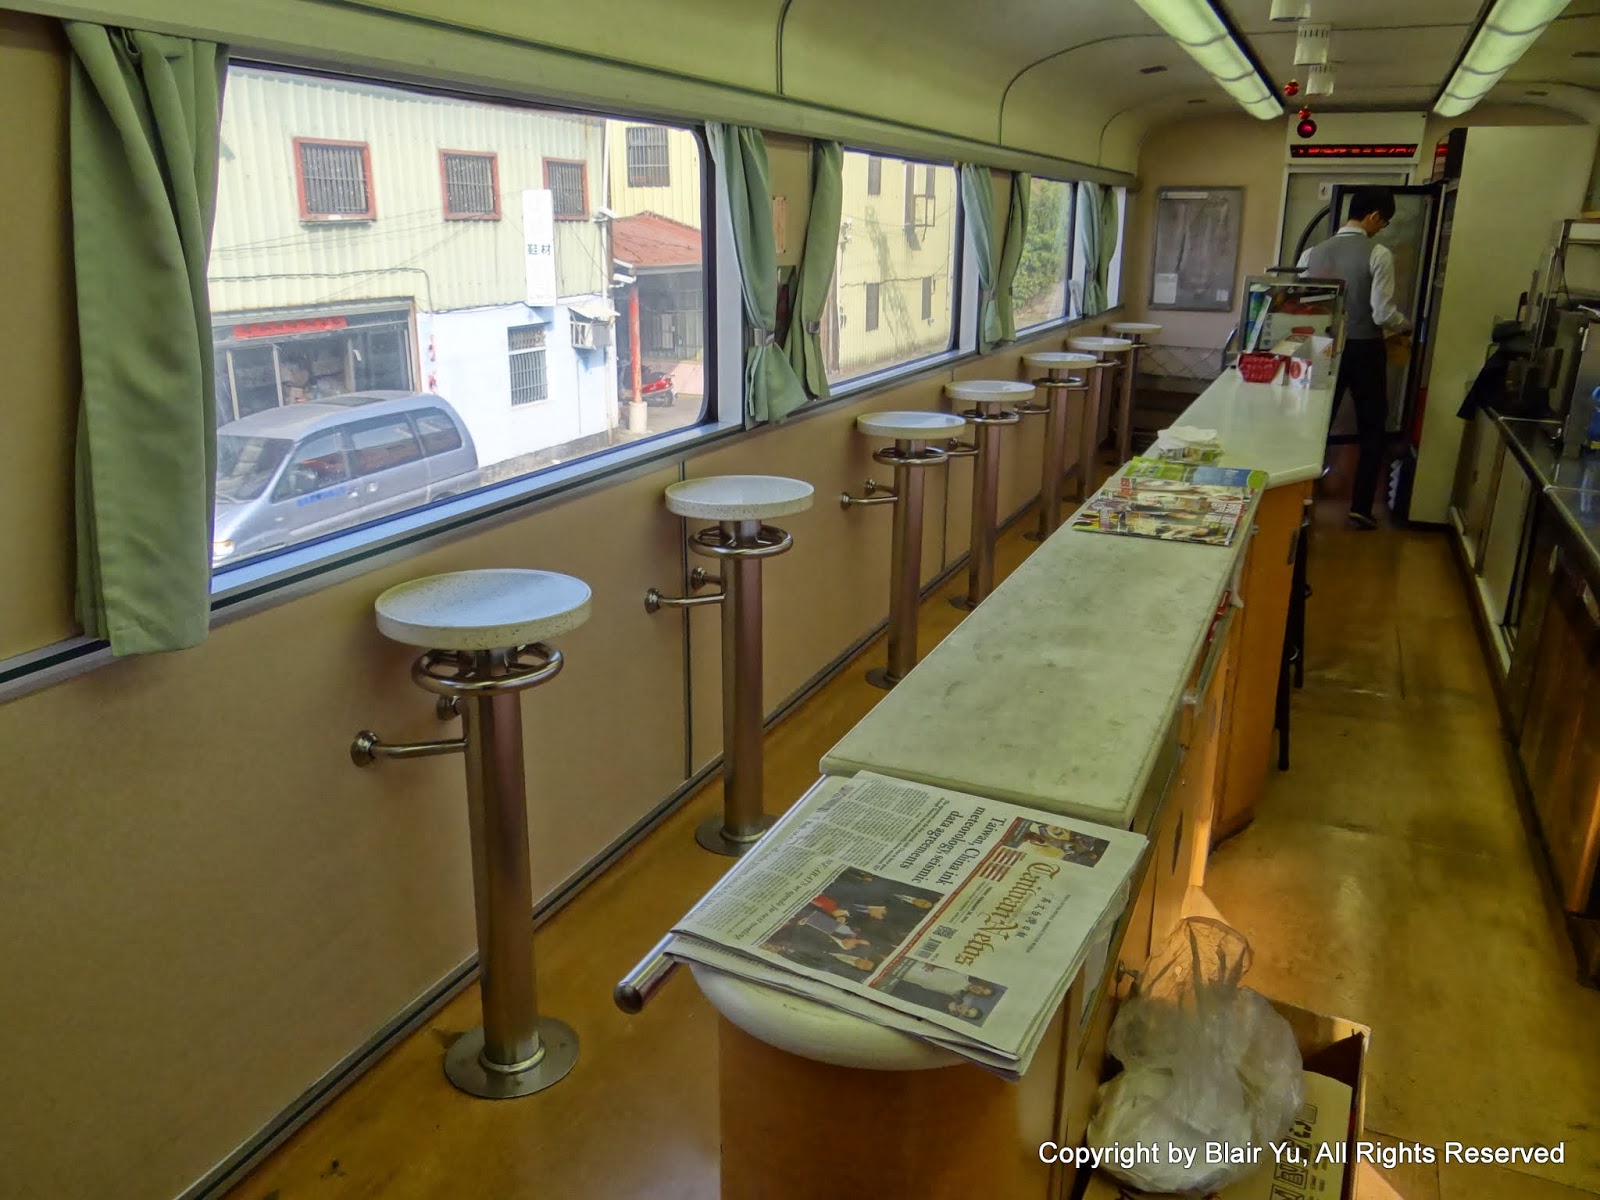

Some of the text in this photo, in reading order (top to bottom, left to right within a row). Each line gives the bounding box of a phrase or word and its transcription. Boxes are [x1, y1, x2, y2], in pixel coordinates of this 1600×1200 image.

[527, 243, 551, 256] 鞋材
[936, 806, 985, 854] meteorology,
[939, 810, 963, 827] data
[968, 817, 1006, 845] Taiwan,
[899, 827, 944, 868] agreements
[948, 848, 980, 870] China
[911, 855, 943, 883] seismic
[935, 871, 955, 885] ink
[991, 862, 1060, 917] Taiwan
[954, 913, 1018, 966] News
